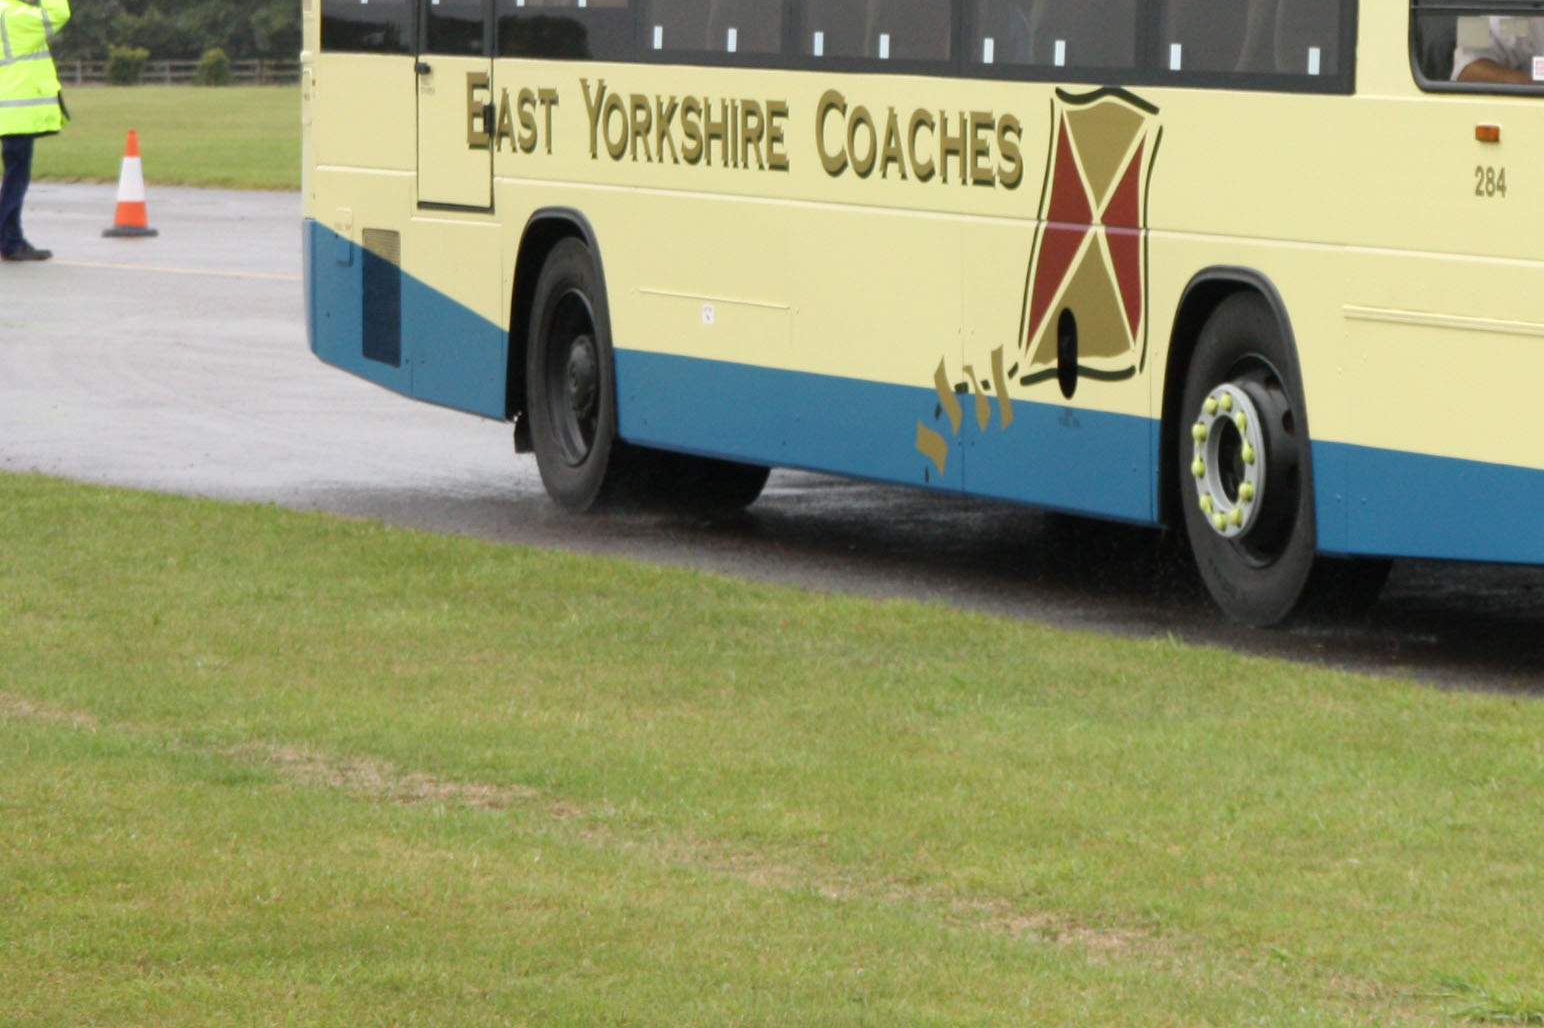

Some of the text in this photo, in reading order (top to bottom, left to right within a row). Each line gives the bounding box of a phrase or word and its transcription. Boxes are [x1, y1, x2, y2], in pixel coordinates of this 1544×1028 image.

[464, 71, 1024, 191] EAST YORKSHIRE COACHES
[1475, 165, 1507, 199] 284
